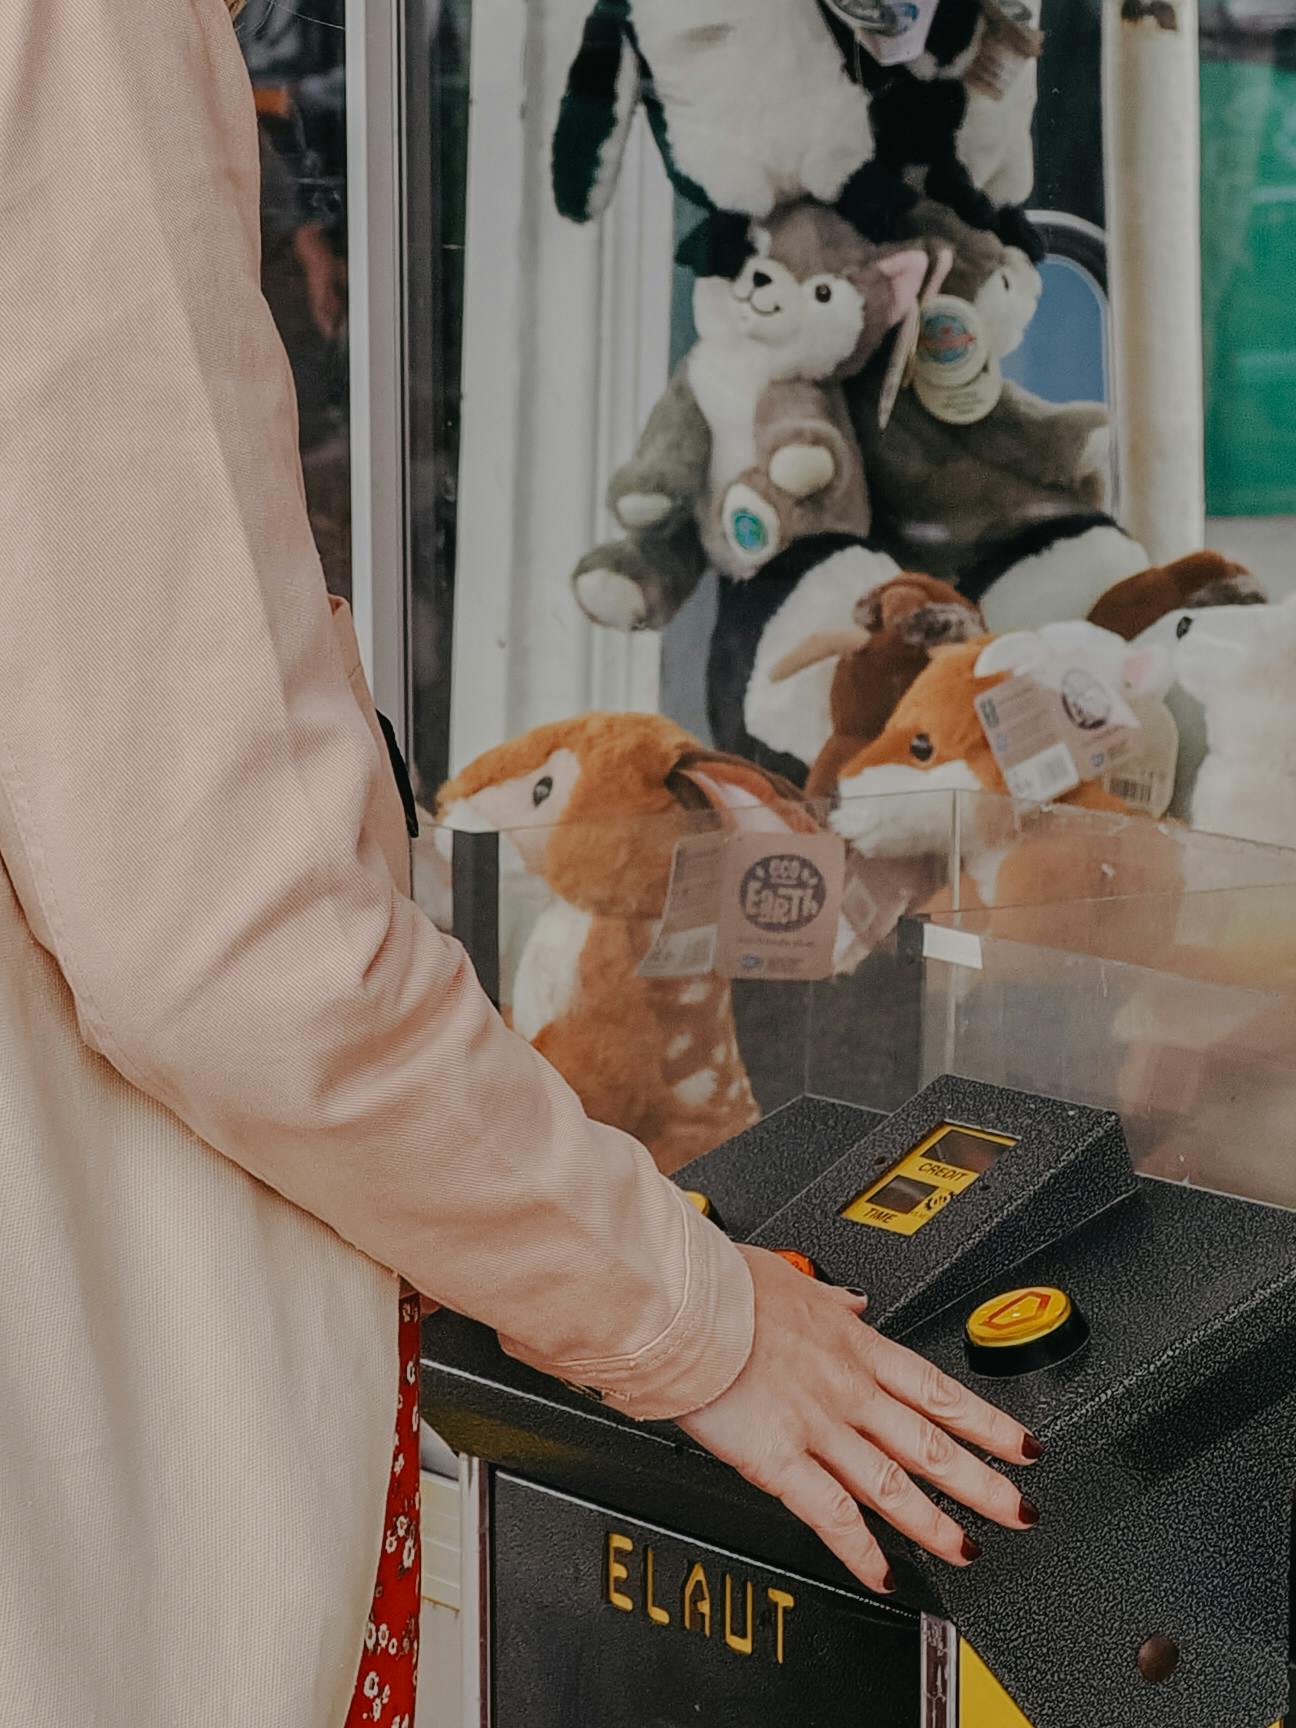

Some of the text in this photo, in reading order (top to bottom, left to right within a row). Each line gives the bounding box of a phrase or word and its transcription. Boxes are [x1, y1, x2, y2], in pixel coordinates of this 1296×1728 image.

[918, 1162, 968, 1182] CREDIT
[863, 1207, 899, 1224] TIME
[607, 1532, 795, 1665] ELAUT
